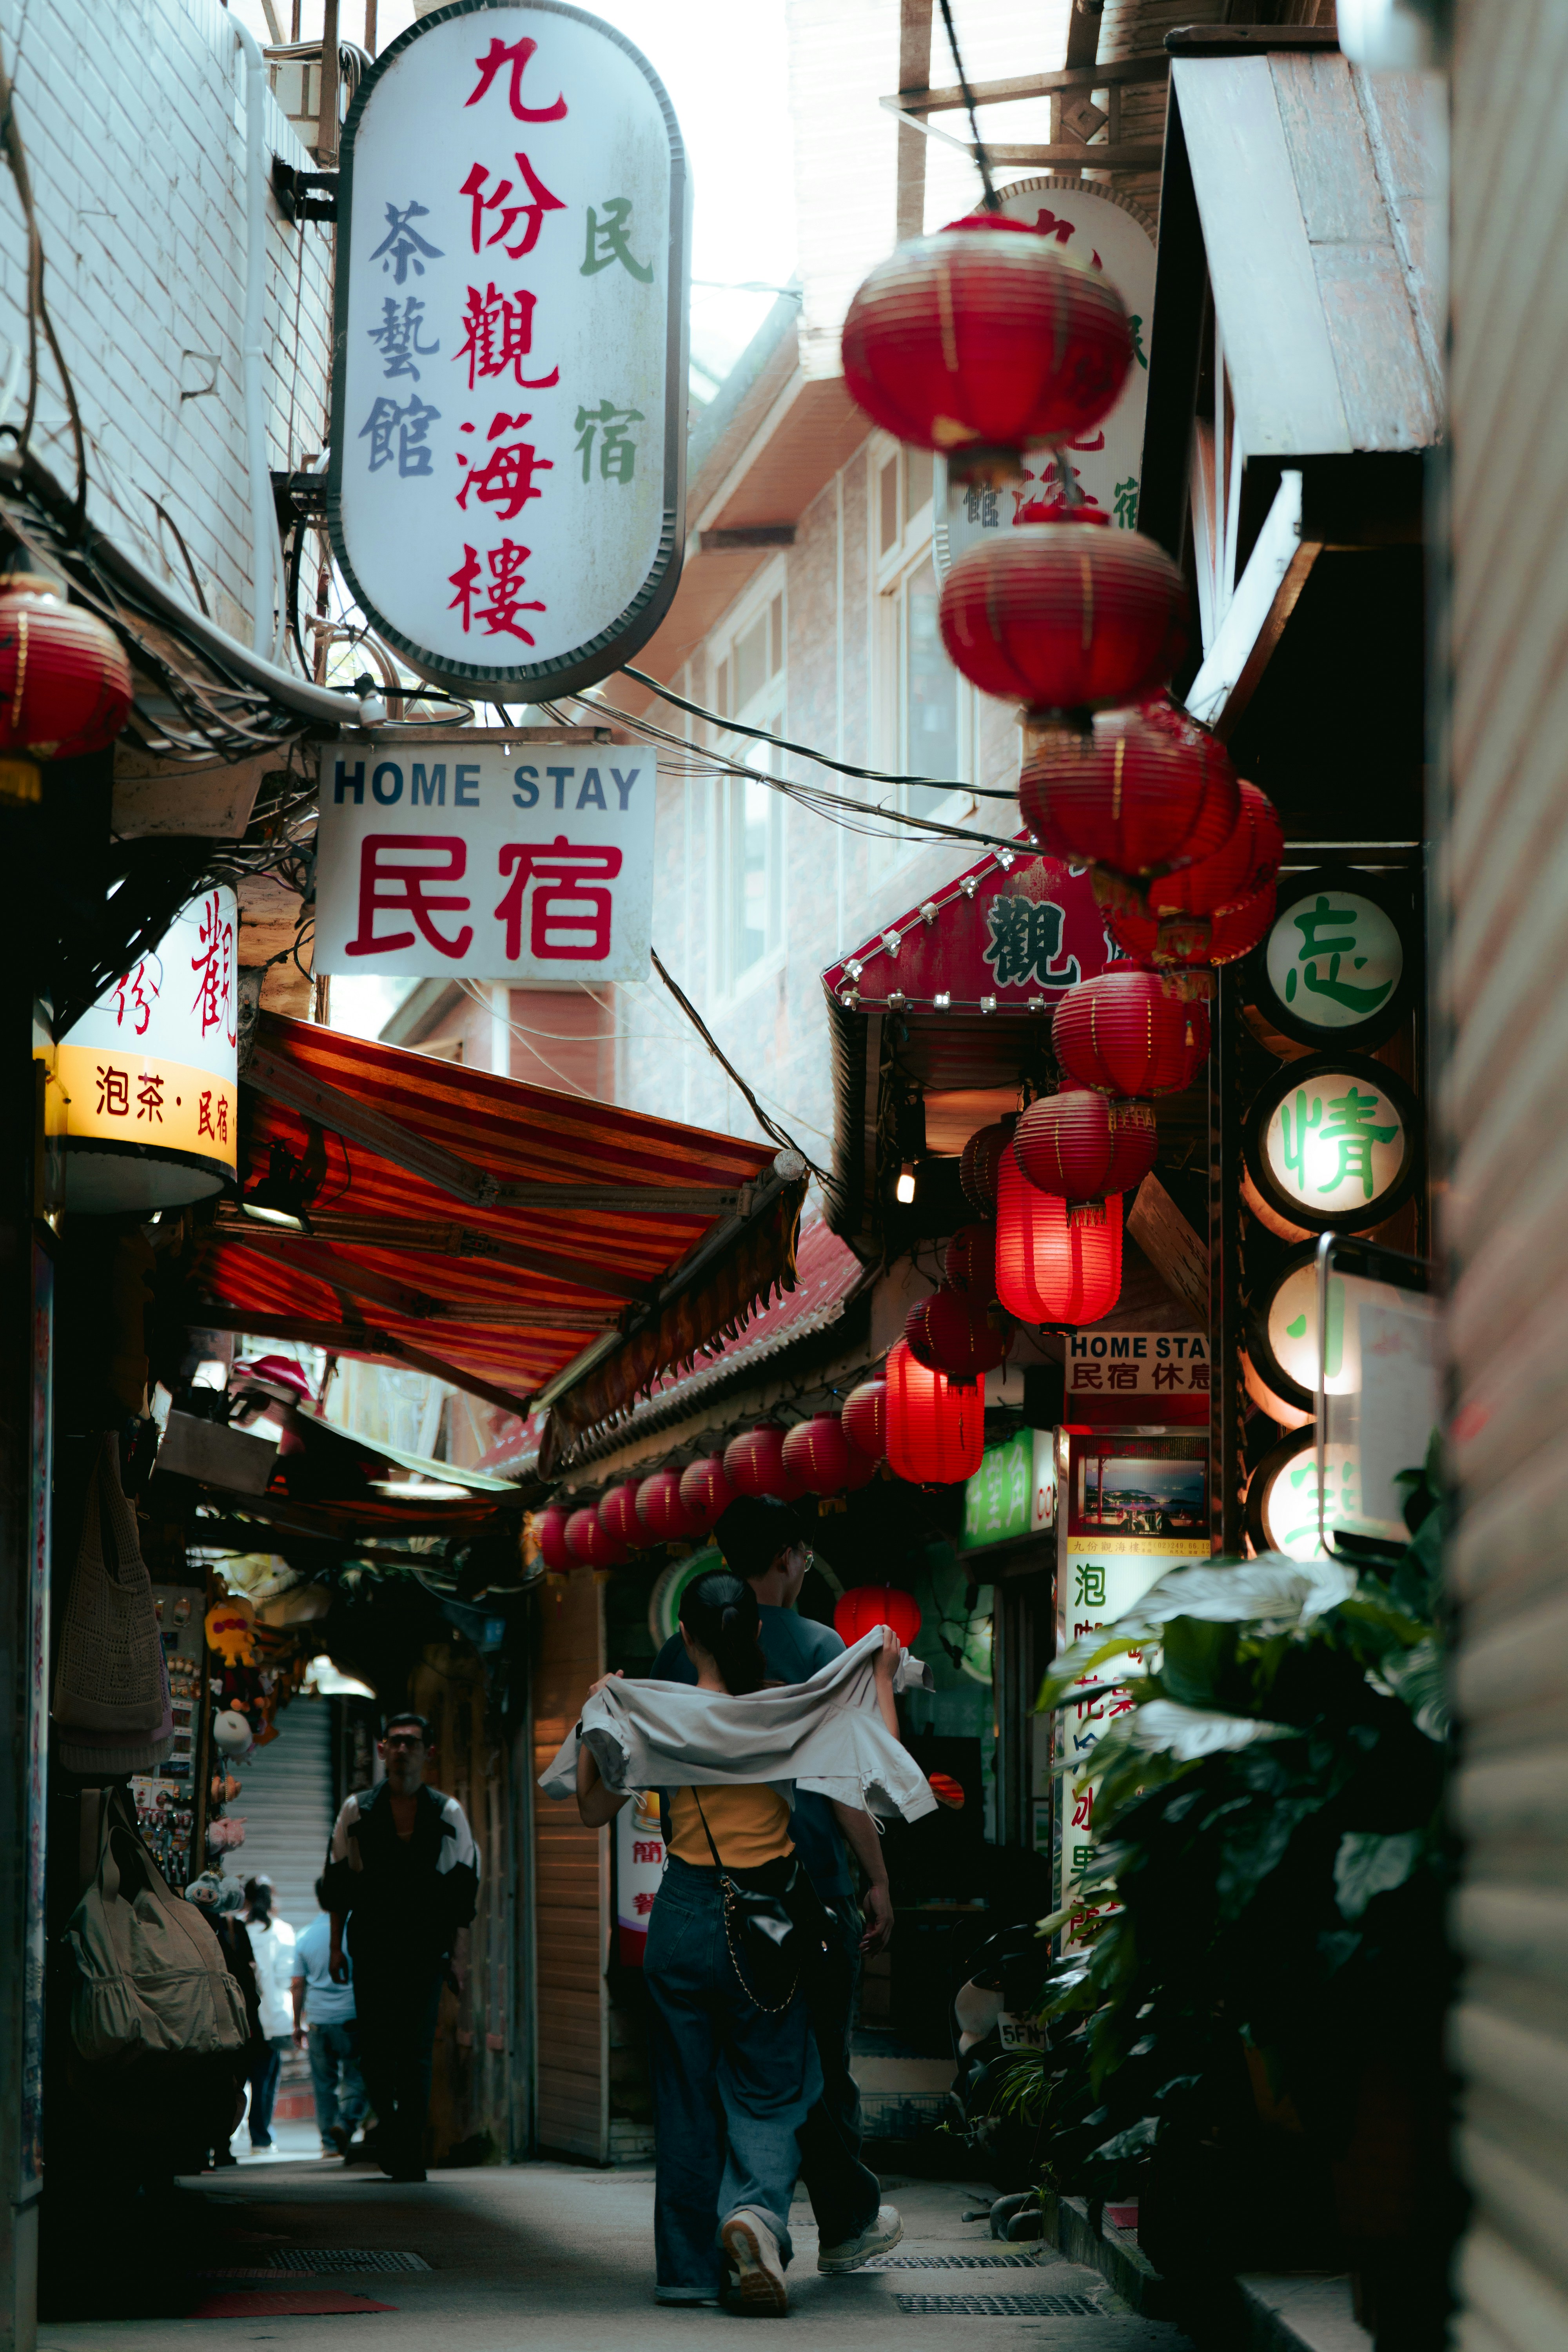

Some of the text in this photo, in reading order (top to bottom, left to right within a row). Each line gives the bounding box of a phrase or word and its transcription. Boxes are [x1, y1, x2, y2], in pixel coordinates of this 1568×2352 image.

[358, 200, 446, 479] 茶藝館
[448, 37, 569, 648] 九份觀海樓
[573, 197, 654, 485] 民宿
[334, 761, 641, 811] HOME STAY
[345, 834, 623, 961] 民宿
[1071, 1337, 1147, 1359] HOME
[1070, 1363, 1140, 1390] 民宿
[1073, 1541, 1140, 1553] 九份觀海樓
[1074, 1564, 1106, 1607] 泡
